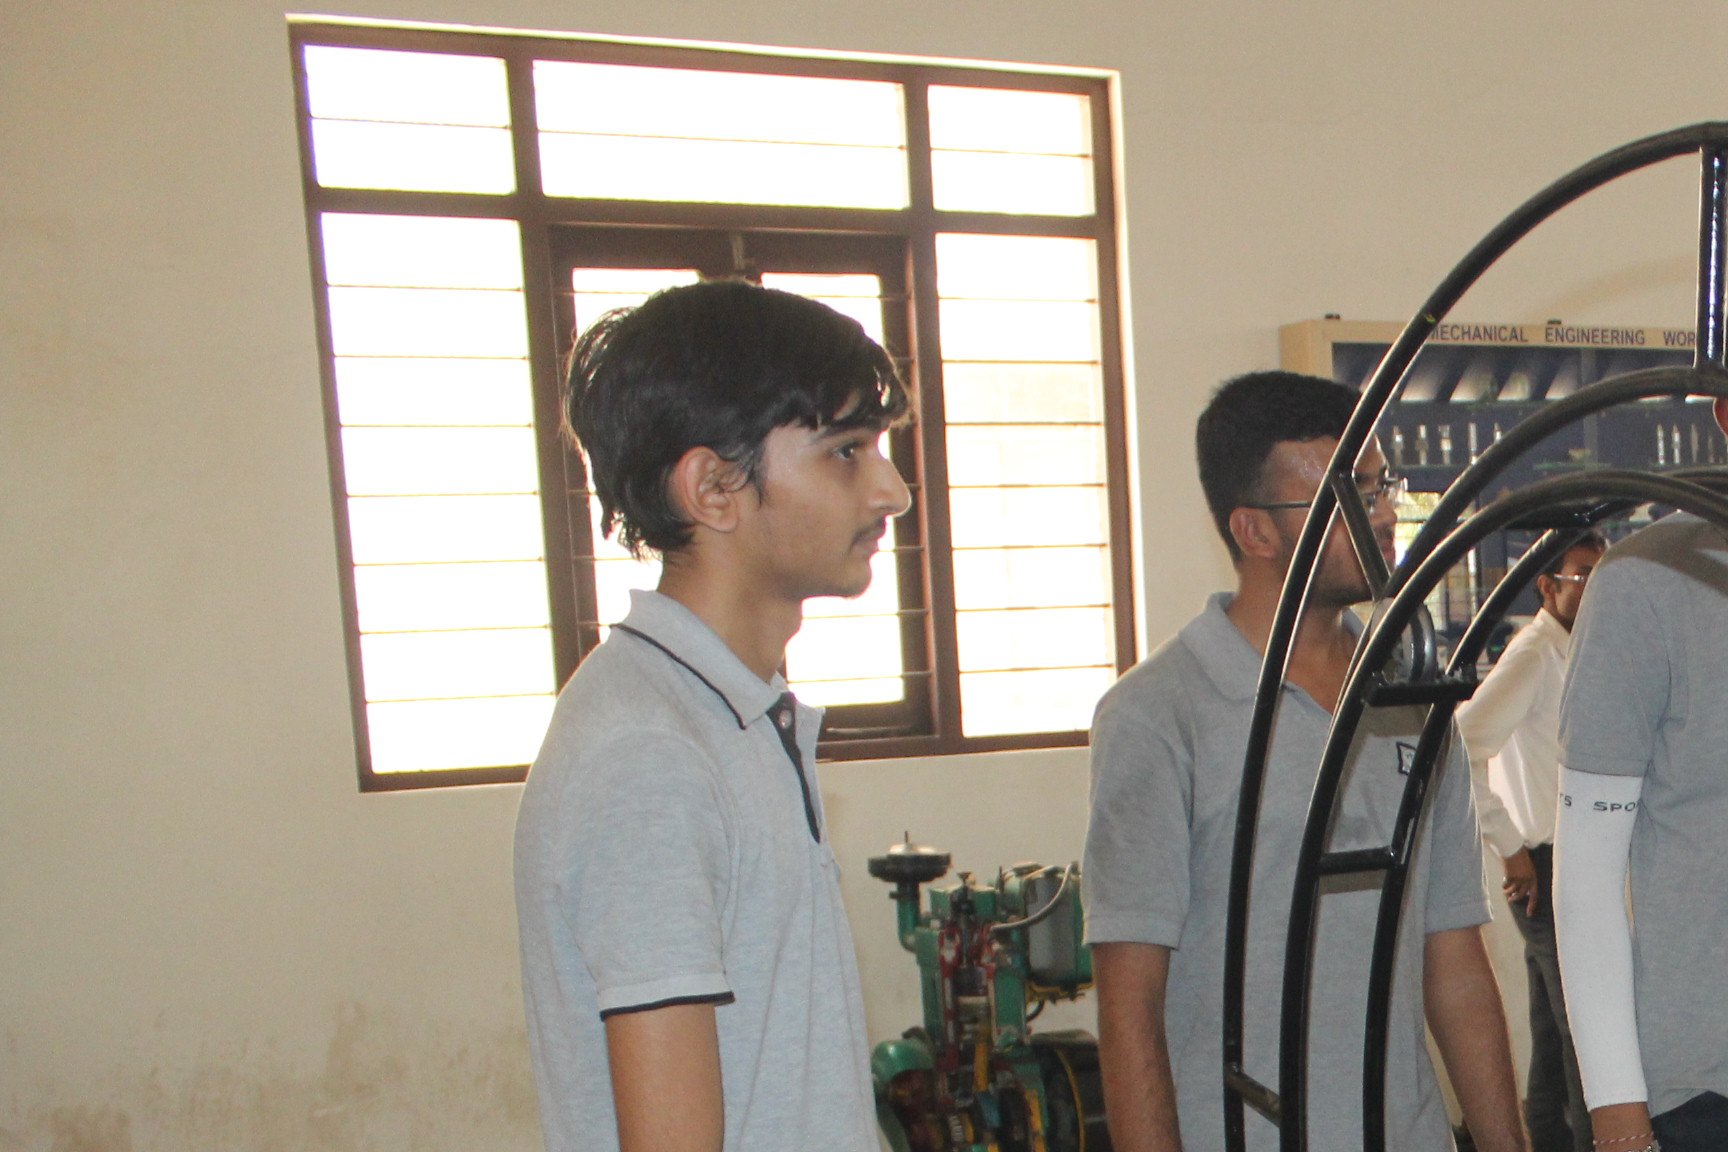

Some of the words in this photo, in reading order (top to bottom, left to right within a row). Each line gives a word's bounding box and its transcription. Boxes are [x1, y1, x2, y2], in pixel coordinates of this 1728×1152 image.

[1545, 327, 1645, 345] ENGINEERING
[1663, 331, 1696, 346] WOR
[1593, 801, 1639, 812] SPO
